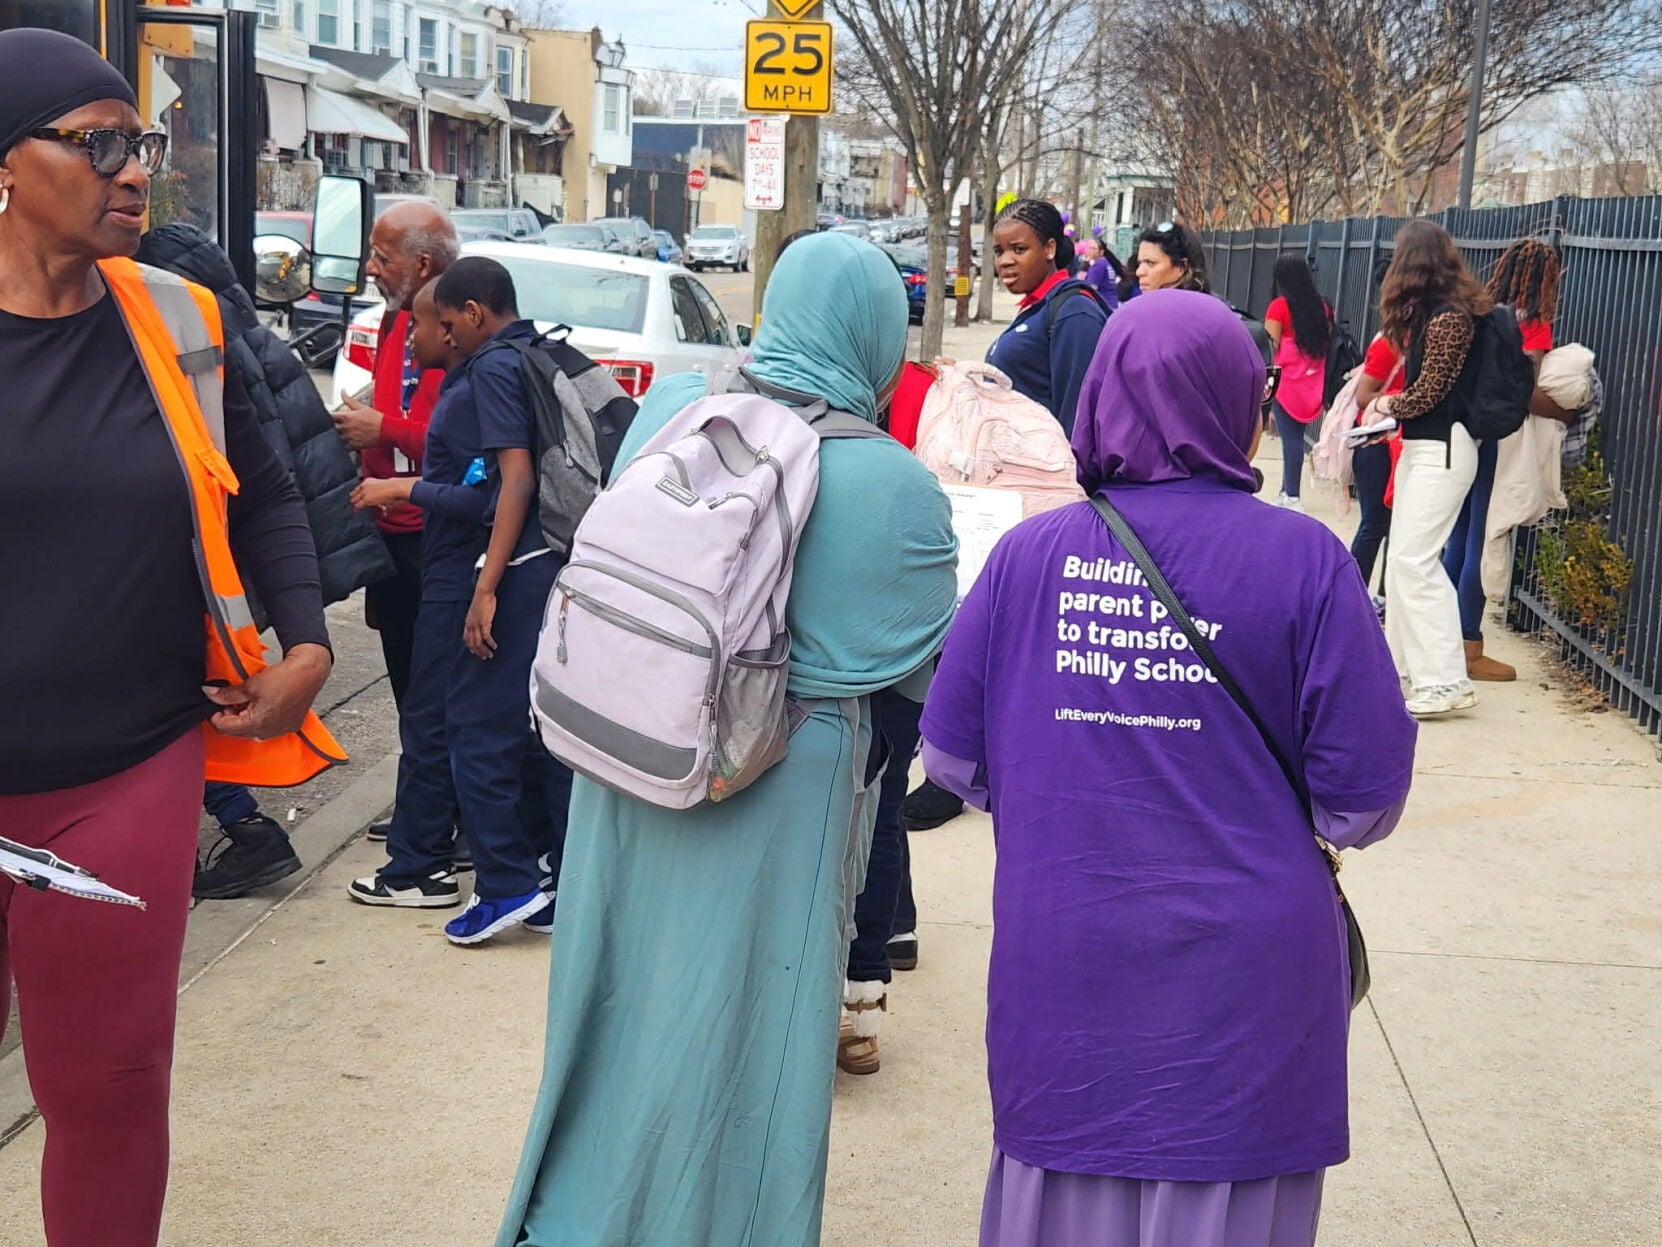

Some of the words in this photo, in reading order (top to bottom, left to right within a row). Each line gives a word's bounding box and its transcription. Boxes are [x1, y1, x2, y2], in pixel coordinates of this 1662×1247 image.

[753, 32, 824, 76] 25
[764, 84, 812, 102] MPH
[748, 122, 760, 140] NO
[749, 147, 780, 160] SCHOOL
[687, 174, 705, 185] STOP
[755, 163, 774, 176] DAYS
[1063, 555, 1149, 588] Buildin
[1059, 591, 1144, 618] parent
[1150, 600, 1223, 641] per
[1057, 618, 1082, 643] to
[1088, 620, 1194, 652] transfo
[1056, 650, 1127, 685] Philly
[1055, 708, 1202, 731] LiftEveryVoicePhilly.org
